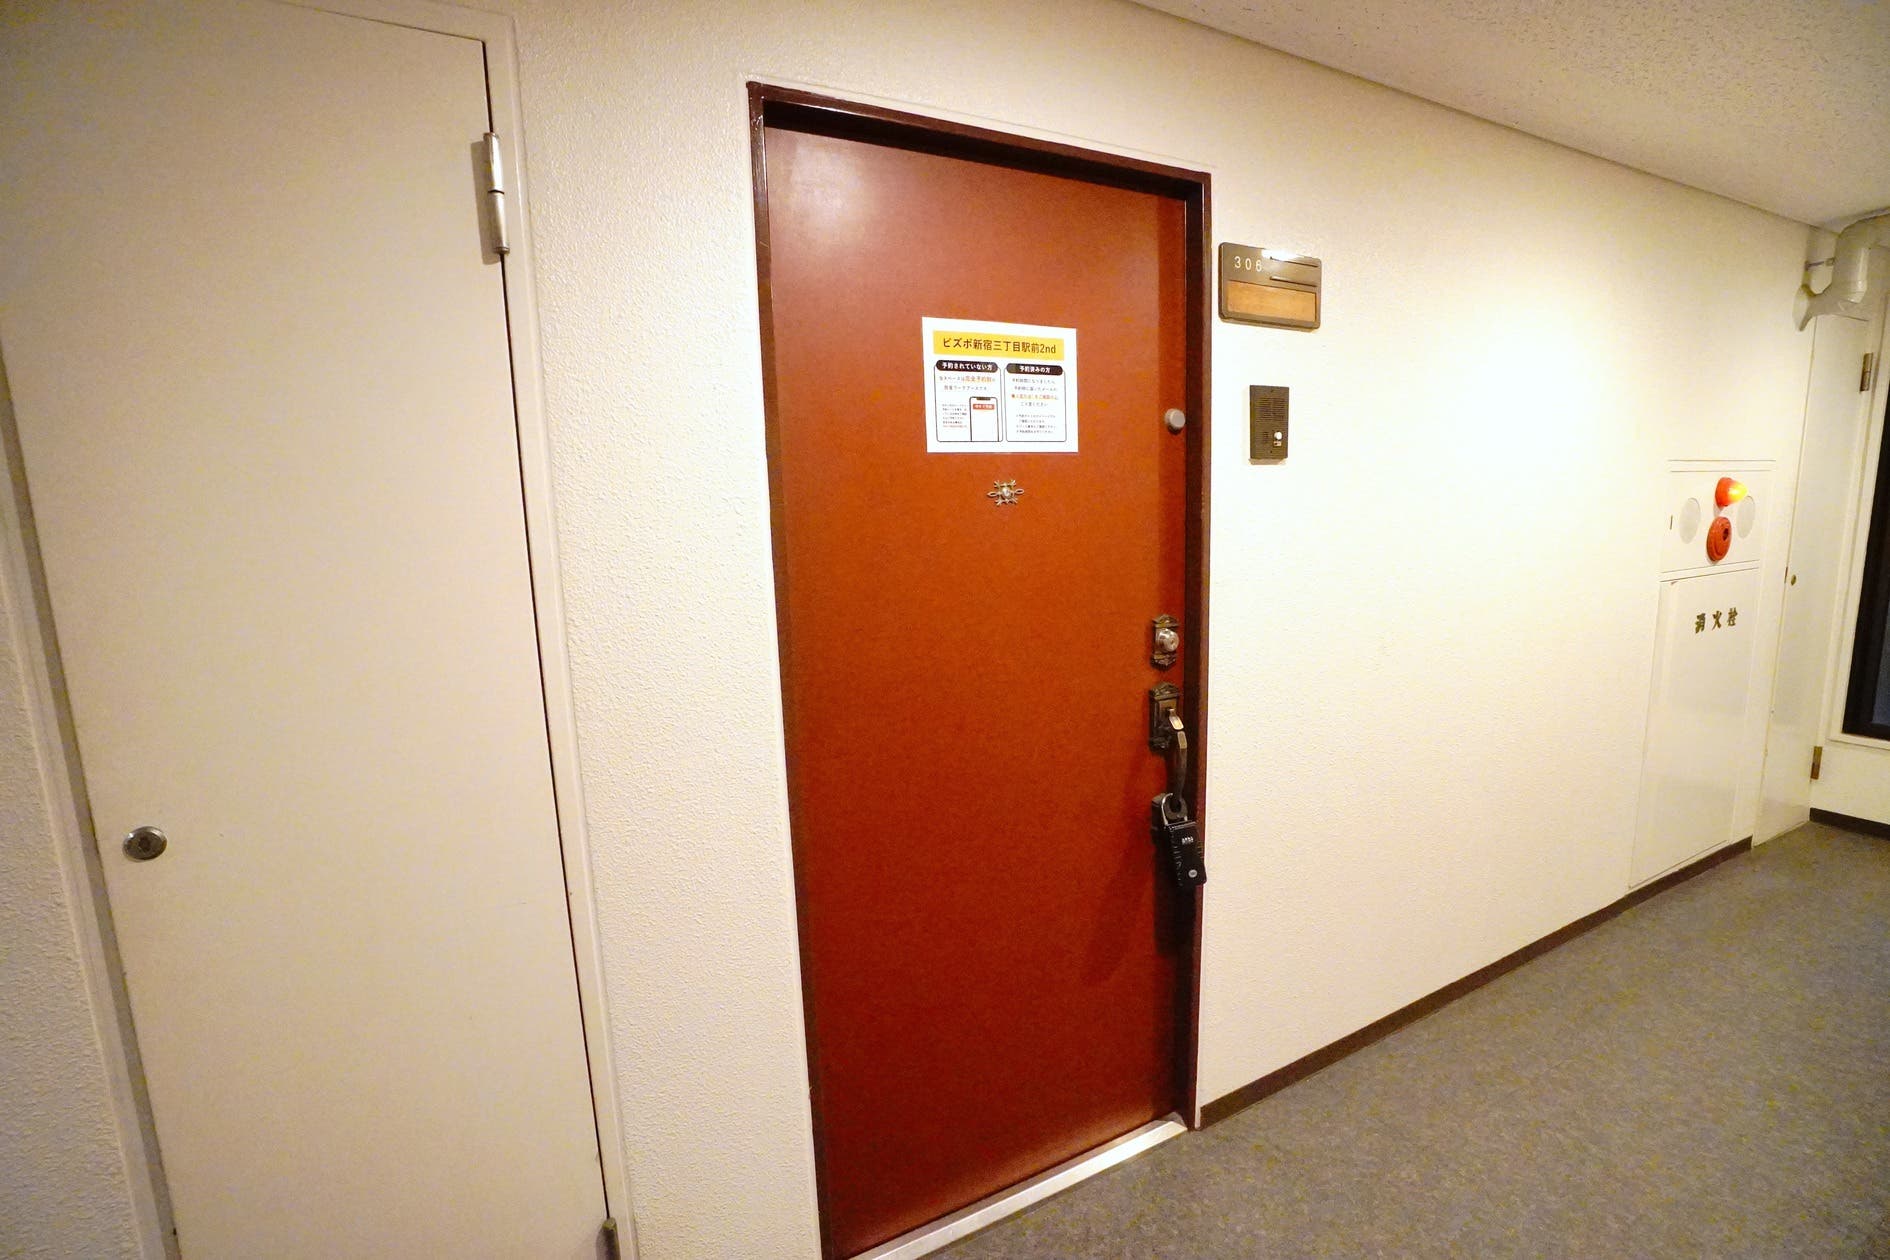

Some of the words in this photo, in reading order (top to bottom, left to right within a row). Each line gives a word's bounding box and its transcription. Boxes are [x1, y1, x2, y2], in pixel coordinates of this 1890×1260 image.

[1234, 256, 1262, 272] 306
[942, 362, 993, 371] 予約されていない方
[1695, 607, 1738, 634] 消火栓
